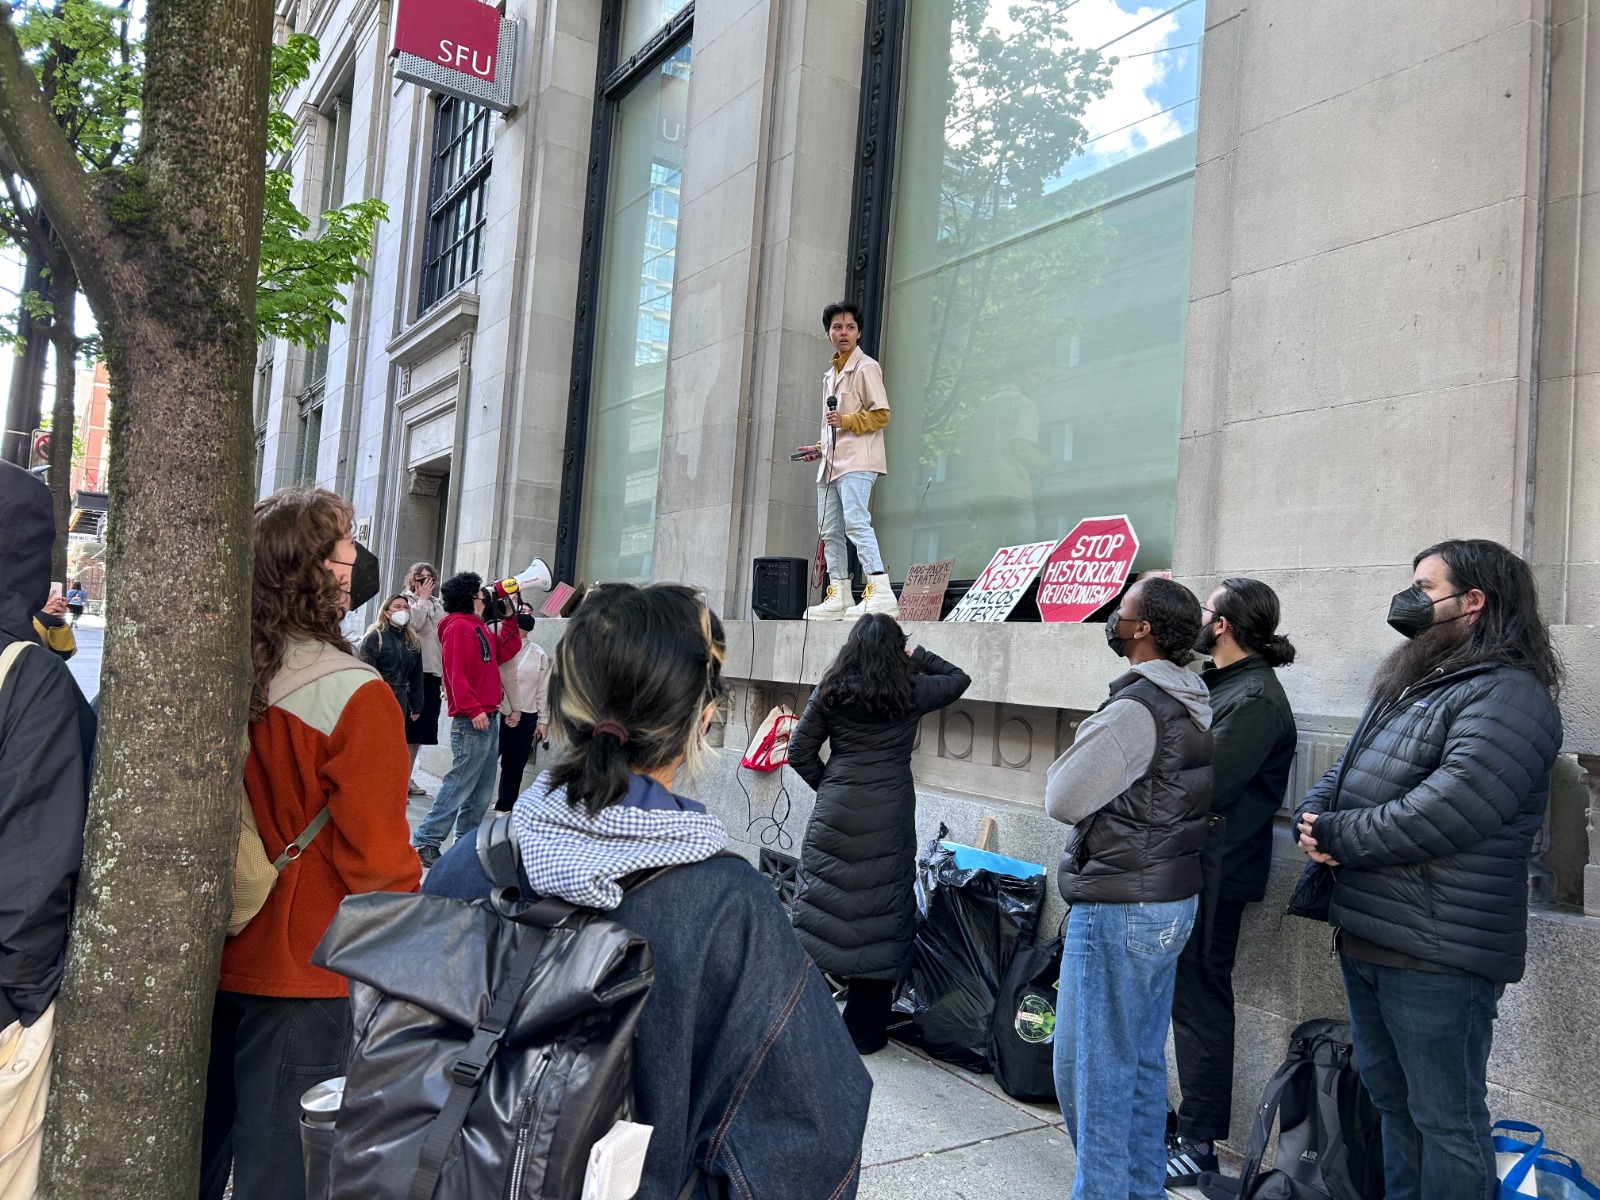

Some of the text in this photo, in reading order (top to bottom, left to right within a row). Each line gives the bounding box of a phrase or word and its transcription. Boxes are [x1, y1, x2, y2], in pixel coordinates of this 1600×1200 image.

[437, 39, 491, 76] SFU
[1071, 533, 1125, 558] STOP
[906, 572, 948, 586] STRATEGY
[1044, 559, 1127, 583] HISTORICAL
[944, 604, 1011, 621] DUTERTE
[1300, 1149, 1318, 1160] AIR
